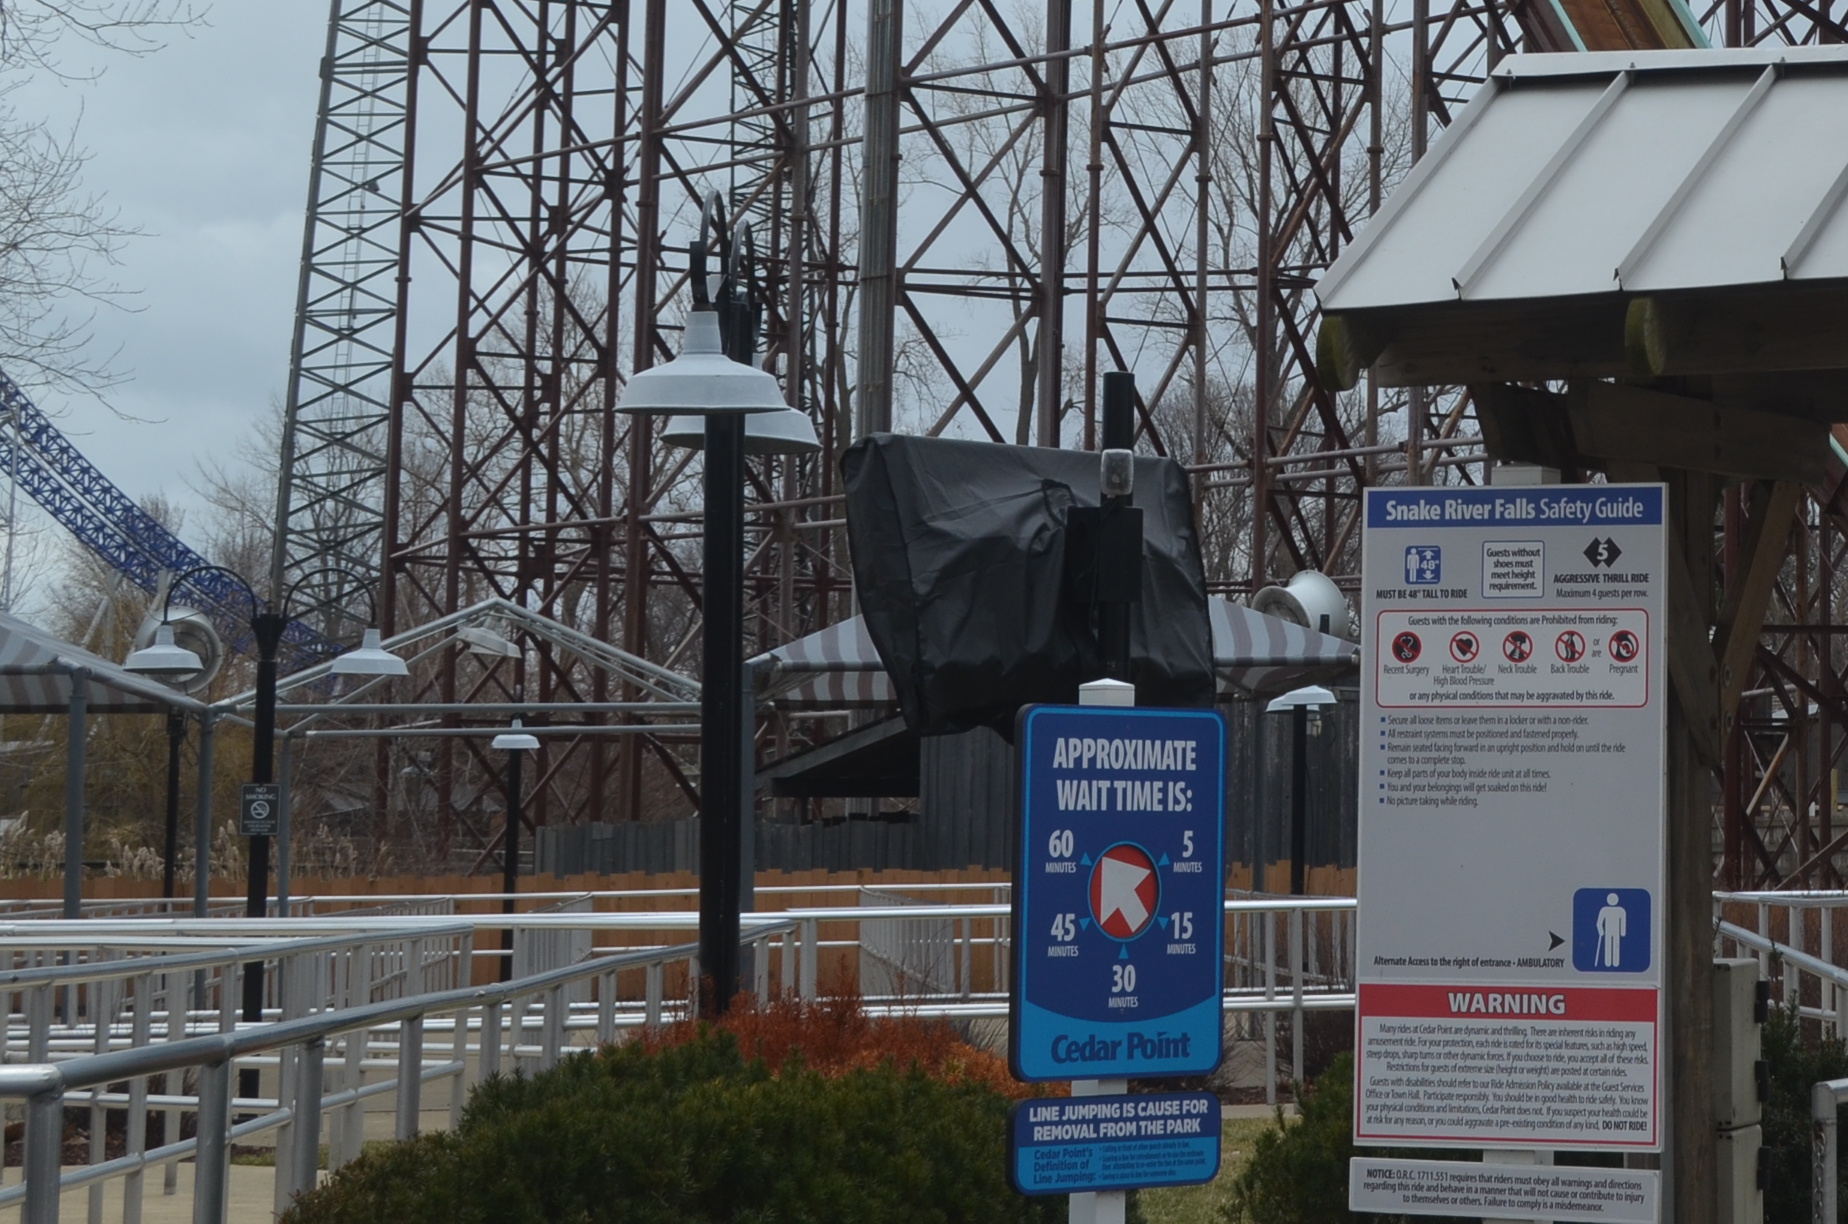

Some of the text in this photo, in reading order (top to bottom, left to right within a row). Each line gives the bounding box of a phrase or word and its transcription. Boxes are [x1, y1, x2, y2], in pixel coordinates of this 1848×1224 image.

[1385, 497, 1644, 524] Snake River Falls Safety Guide
[1486, 548, 1541, 558] Guests without
[1597, 544, 1609, 560] 5
[1420, 560, 1440, 570] 48"
[1493, 558, 1534, 568] shoes must
[1491, 570, 1536, 582] meet height
[1553, 573, 1650, 583] AGGRESSIVE THRILL RIDE
[1489, 580, 1538, 593] requirement.
[1376, 589, 1468, 599] MUST BE 48" TALL TO RIDE
[1556, 588, 1649, 600] Maximum 4 guests per row.
[1408, 615, 1618, 628] Guests with the following conditions are Prohibited from riding:
[1383, 664, 1430, 676] Recent Surgery
[1442, 664, 1487, 676] Heart Trouble/
[1498, 664, 1538, 674] Neck Trouble
[1550, 664, 1590, 674] Back Trouble
[1609, 664, 1638, 676] Pregnant
[1433, 676, 1495, 688] High Blood Pressure
[1409, 690, 1615, 702] or any physical conditions that may be aggravated by this ride.
[1052, 737, 1197, 771] APPROXIMATE
[1056, 780, 1193, 812] WAIT TIME IS:
[1386, 796, 1479, 808] No picture taking while riding.
[1048, 830, 1074, 858] 60
[1182, 831, 1194, 858] 5
[1045, 860, 1077, 874] MINUTES
[1173, 860, 1203, 873] MINUTES
[1050, 913, 1076, 942] 45
[1171, 912, 1193, 939] 15
[1047, 944, 1079, 957] MINUTES
[1166, 942, 1196, 955] MINUTES
[1373, 955, 1565, 969] Alternate Access to the right of entrance AMBULATORY
[1111, 965, 1137, 992] 30
[1108, 995, 1139, 1008] MINUTES
[1448, 993, 1566, 1014] WARNING
[1050, 1030, 1191, 1064] Cedar Point
[1030, 1100, 1208, 1122] LINE JUMPING IS CAUSE FOR
[1034, 1118, 1200, 1141] REMOVAL FROM THE PARK
[1601, 1120, 1647, 1131] DO NOT RIDE!
[1034, 1148, 1060, 1160] Cedar
[1062, 1146, 1093, 1159] Point's
[1034, 1159, 1078, 1172] Definition
[1079, 1158, 1090, 1170] of
[1033, 1172, 1052, 1184] Line
[1054, 1170, 1096, 1186] Jumping:
[1403, 1192, 1604, 1212] to themselves or others. Failure to comply is a misdemeanor.
